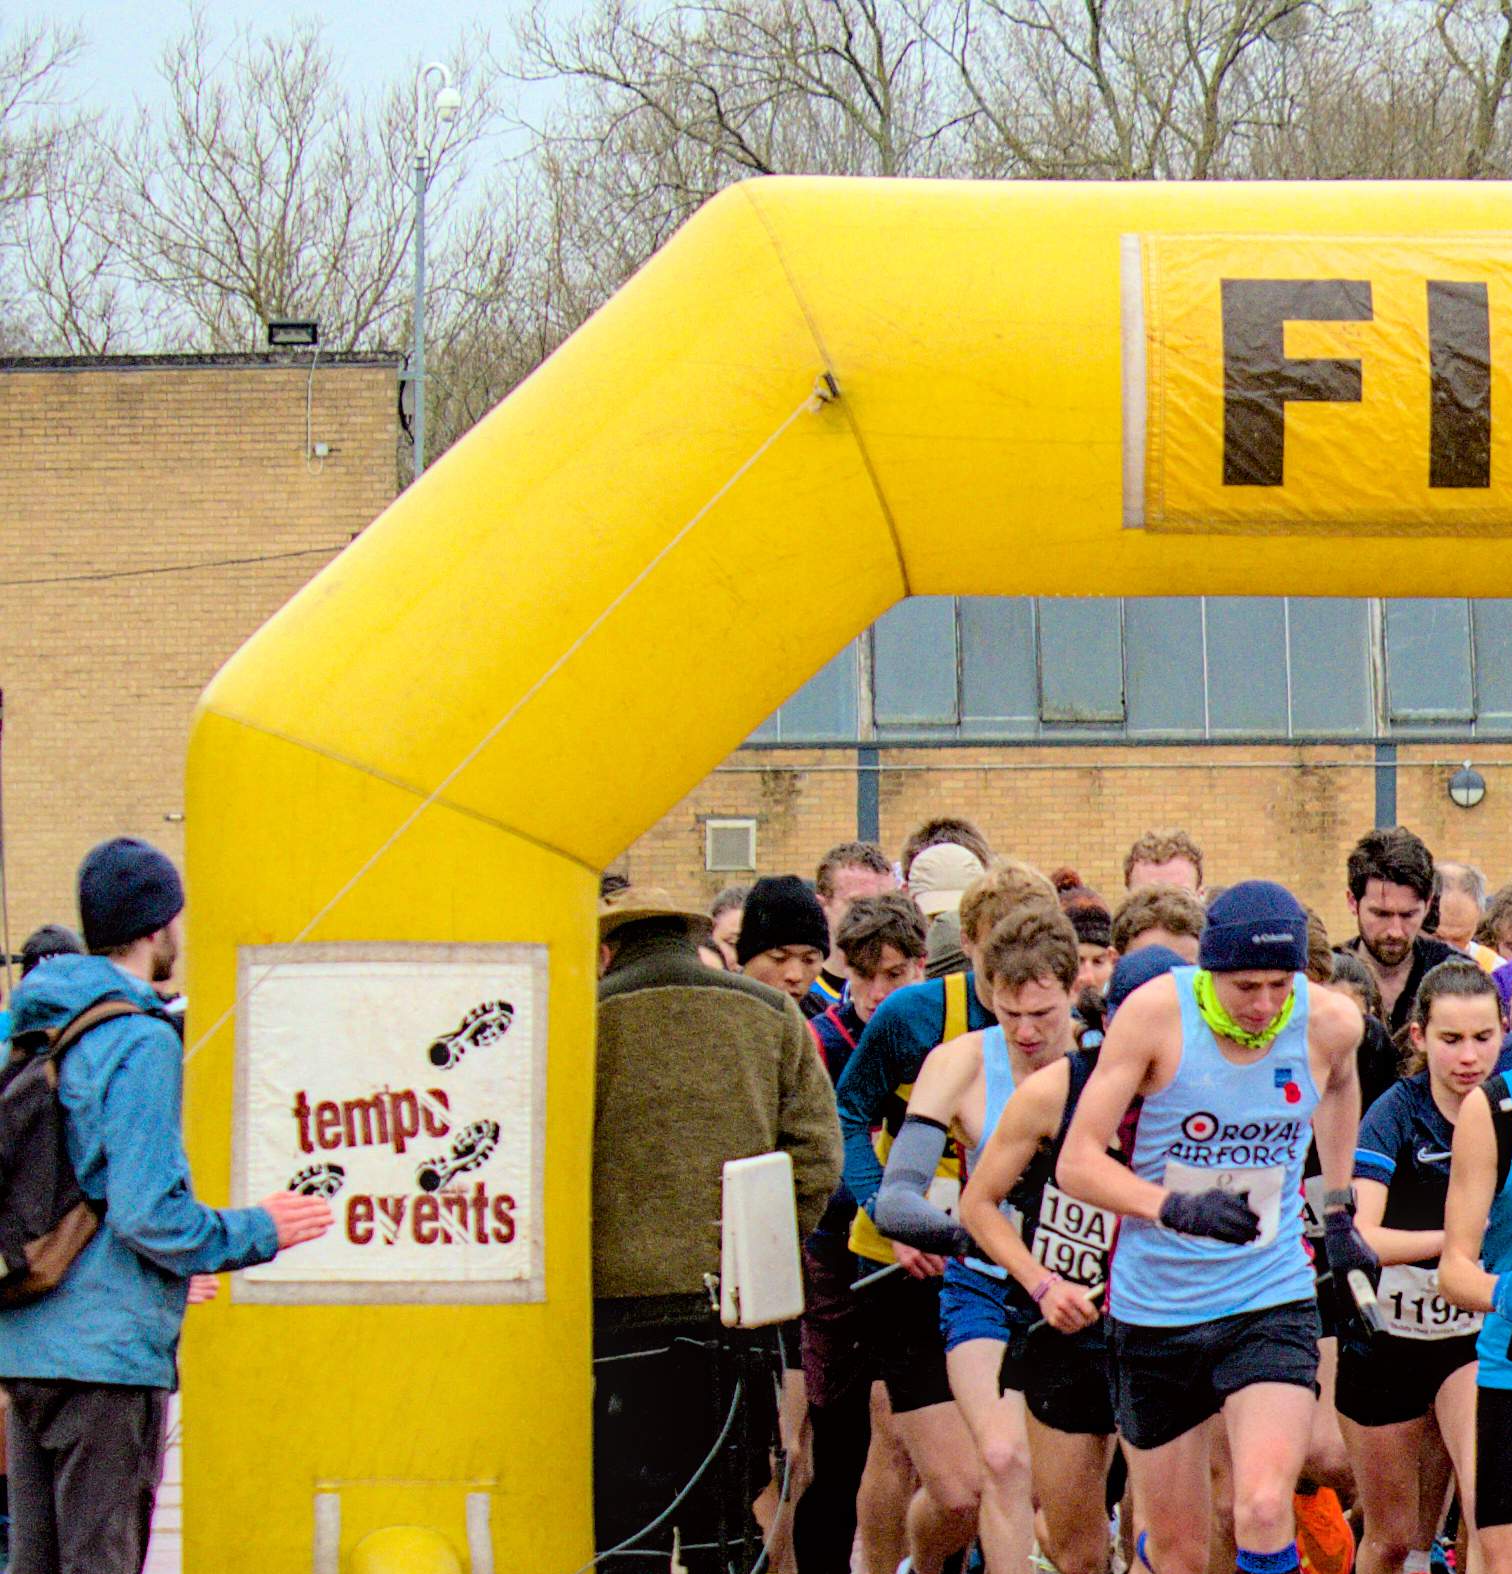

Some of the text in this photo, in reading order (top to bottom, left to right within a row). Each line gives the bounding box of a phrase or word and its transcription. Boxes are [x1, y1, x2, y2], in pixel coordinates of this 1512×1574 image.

[292, 1087, 452, 1155] tempo
[1219, 1121, 1301, 1143] ROYAL
[344, 1181, 517, 1246] events
[1047, 1196, 1106, 1244] 19A
[1038, 1236, 1100, 1282] 19C
